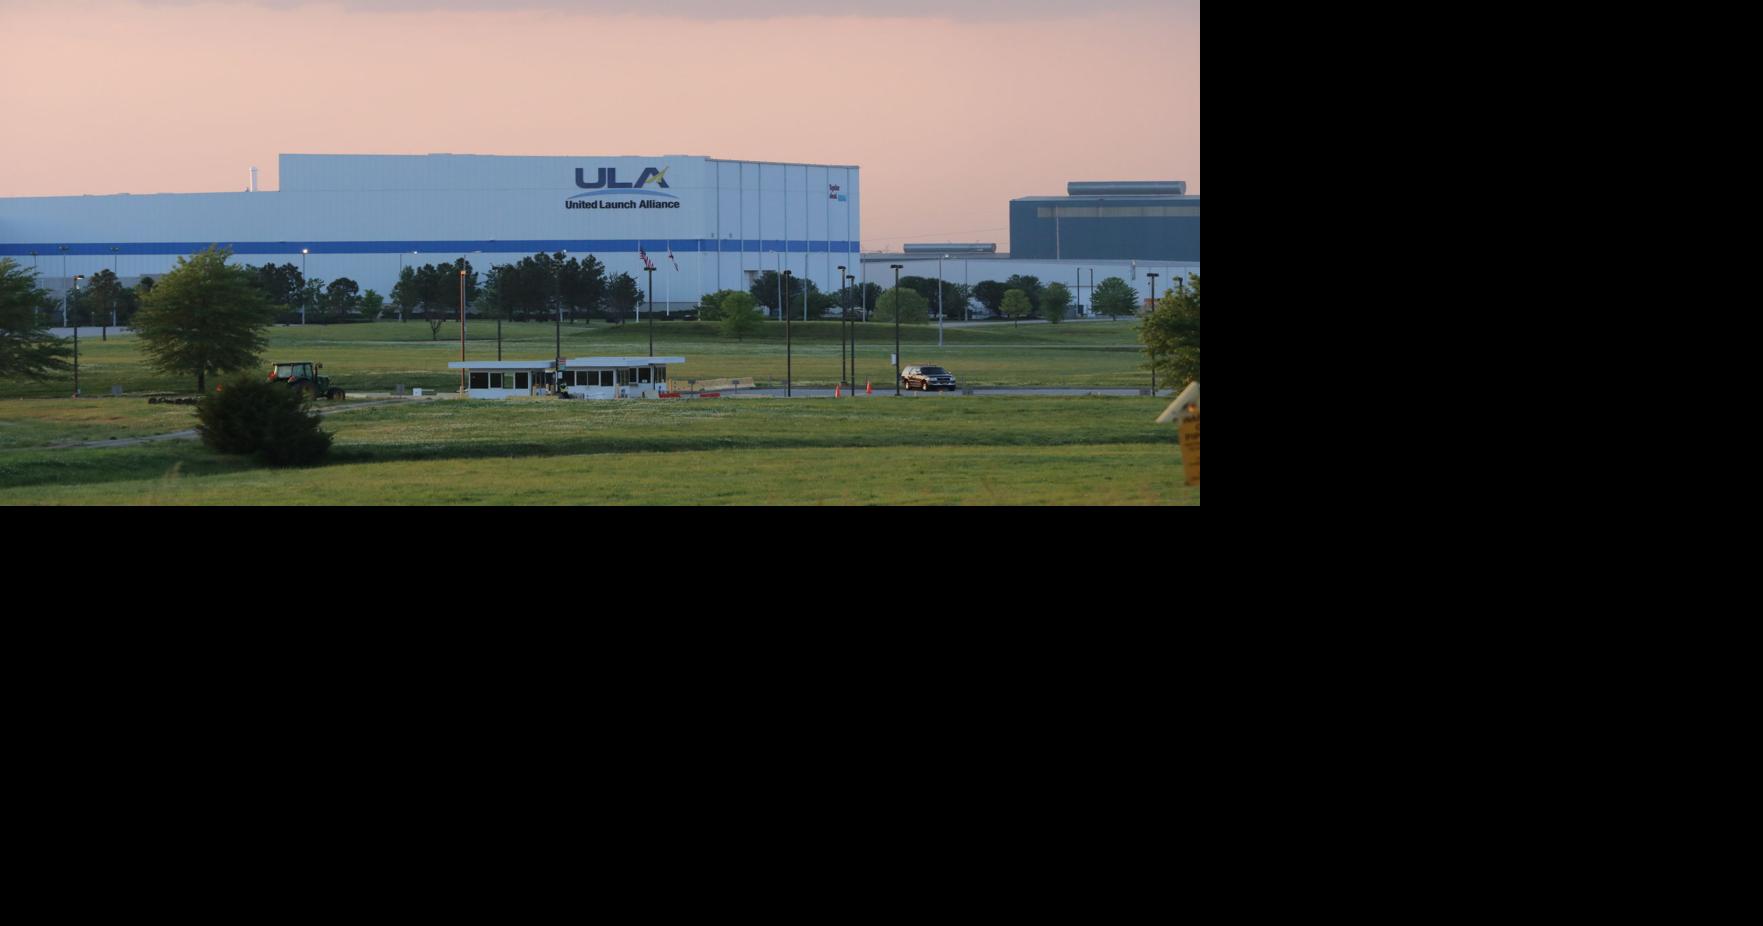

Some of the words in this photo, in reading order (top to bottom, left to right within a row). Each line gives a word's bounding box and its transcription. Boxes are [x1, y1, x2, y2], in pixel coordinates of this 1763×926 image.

[575, 167, 670, 189] ULA
[565, 200, 598, 209] United
[599, 200, 636, 209] Launch
[639, 200, 680, 209] Alliance
